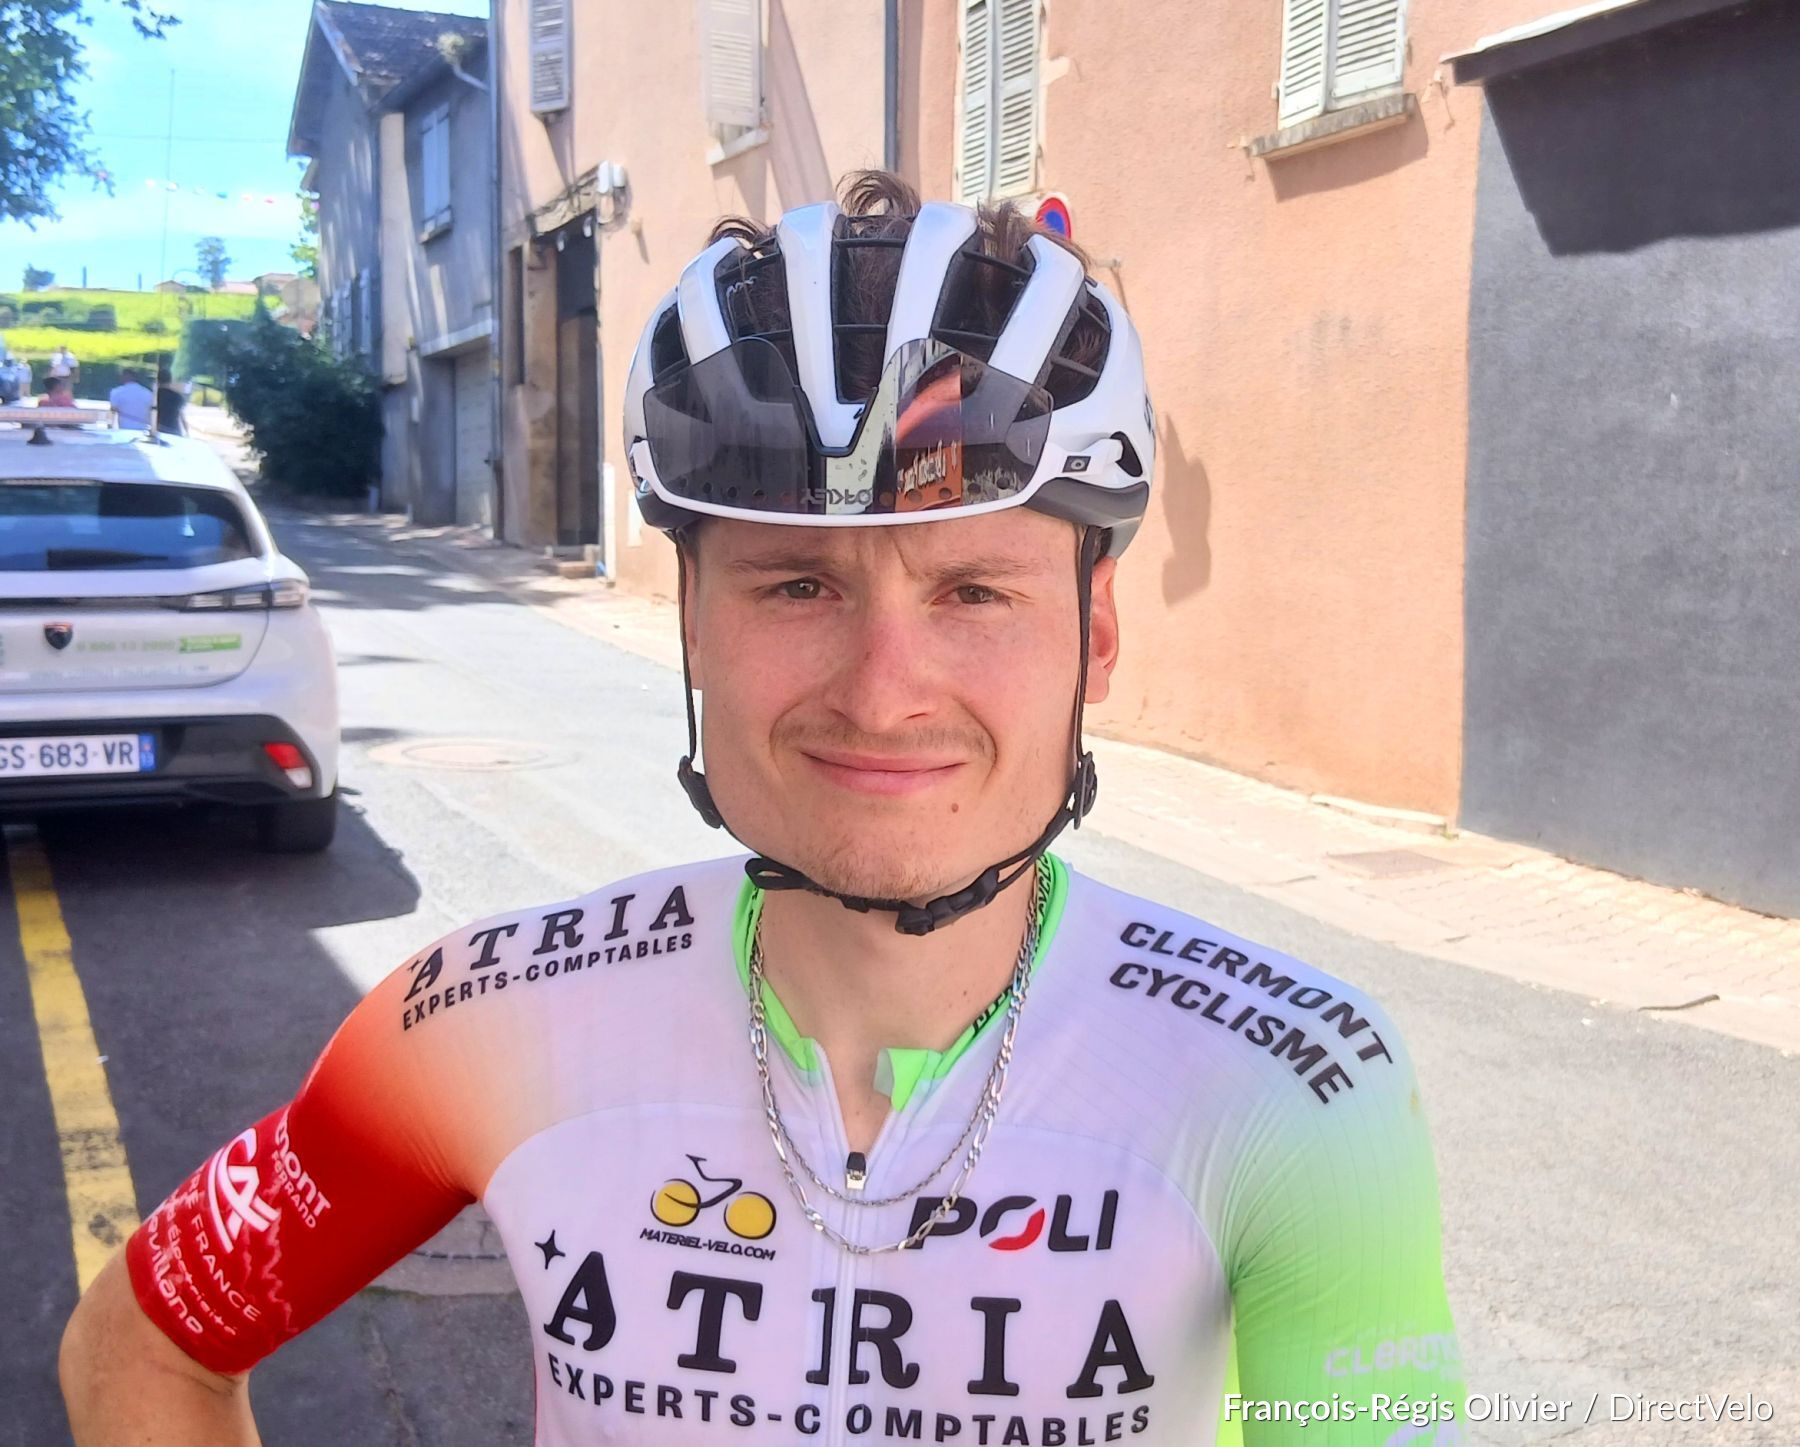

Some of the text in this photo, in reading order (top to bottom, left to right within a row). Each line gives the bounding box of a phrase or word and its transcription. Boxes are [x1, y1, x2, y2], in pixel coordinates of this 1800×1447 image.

[403, 884, 695, 1003] ATRIA
[403, 932, 693, 1032] EXPERTS-COMPTABLES
[1119, 922, 1393, 1065] CLERMONT
[1109, 962, 1354, 1104] CYCLISME
[192, 1213, 262, 1322] FRANCE
[640, 1228, 776, 1261] MATERIEL-VELO.COM
[904, 1189, 1119, 1252] POLI
[543, 1250, 1155, 1399] ATRIA
[548, 1352, 1150, 1447] EXPERTS-COMPTABLES
